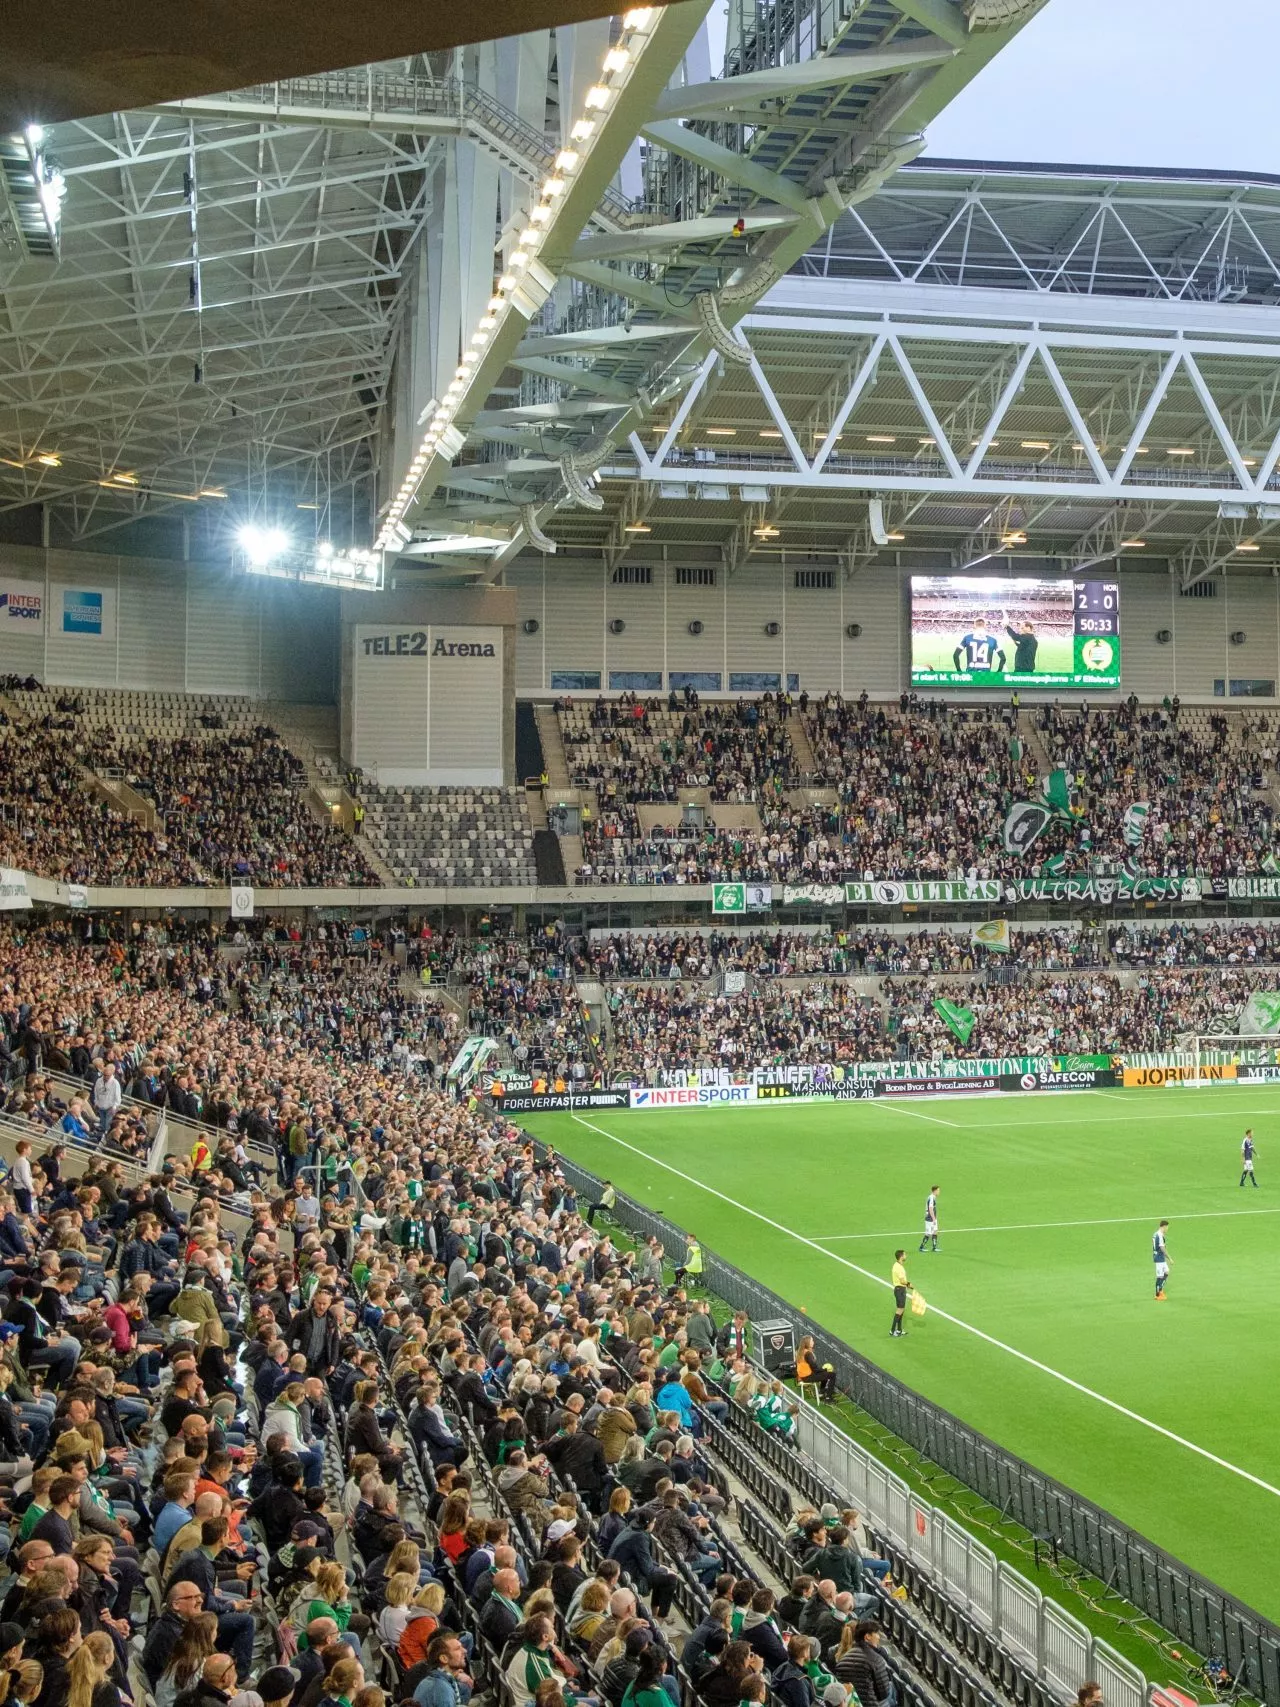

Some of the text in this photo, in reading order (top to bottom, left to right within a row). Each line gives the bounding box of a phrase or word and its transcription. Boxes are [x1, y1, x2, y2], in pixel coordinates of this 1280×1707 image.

[8, 594, 41, 608] INTER
[1079, 594, 1088, 609] 2
[1103, 595, 1113, 609] 0
[8, 606, 42, 620] SPORT
[1080, 618, 1112, 631] 50:33
[363, 631, 496, 657] TELE2 Arena
[969, 641, 989, 662] 14
[1018, 879, 1097, 901] ULTRA
[1137, 1066, 1223, 1085] JOBMAN
[792, 1080, 878, 1093] MASKINKONSULT
[927, 1082, 933, 1090] &
[983, 1080, 995, 1088] AB
[651, 1087, 750, 1104] INTERSPORT
[862, 1089, 875, 1099] AB
